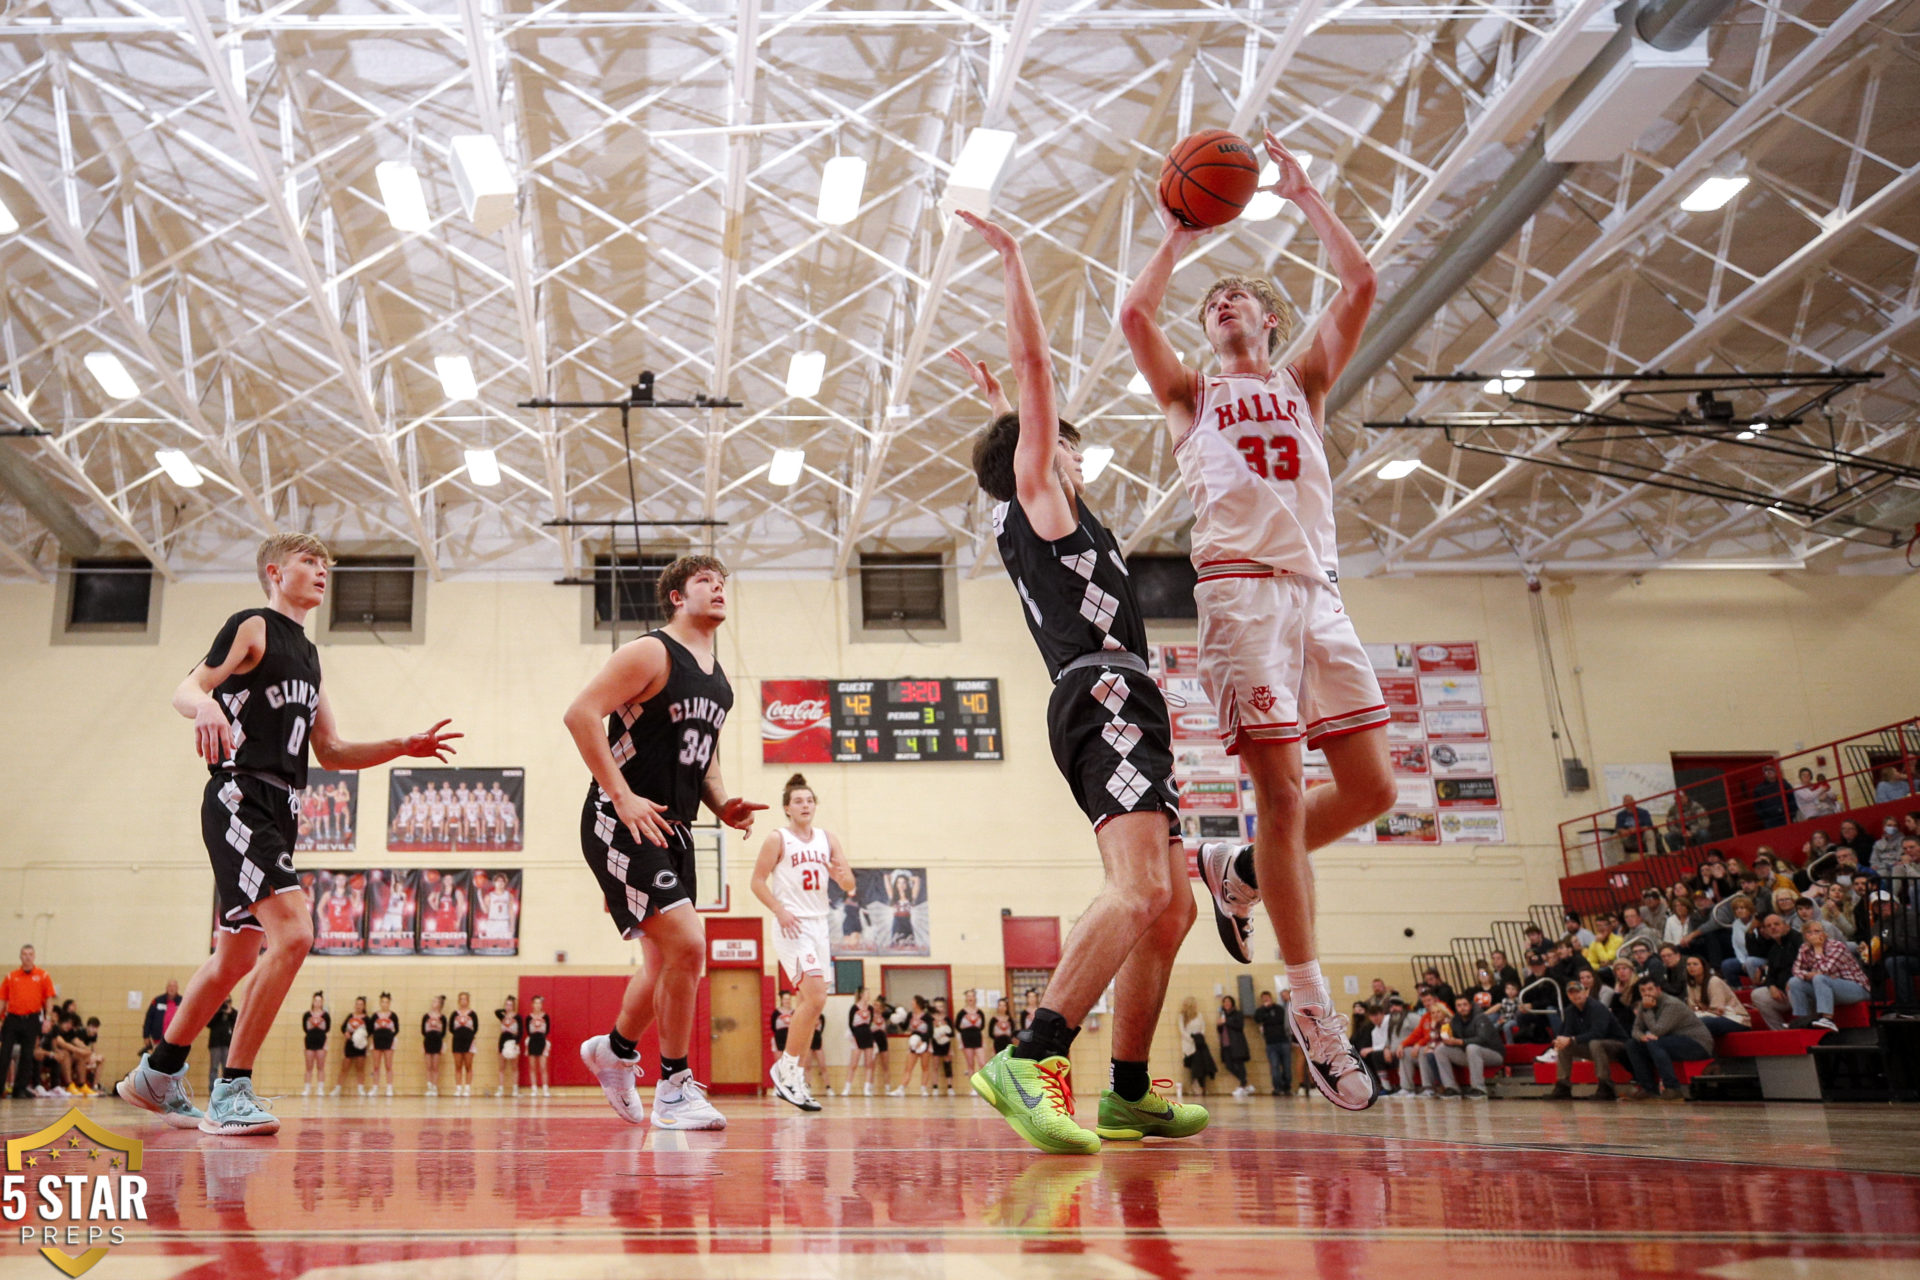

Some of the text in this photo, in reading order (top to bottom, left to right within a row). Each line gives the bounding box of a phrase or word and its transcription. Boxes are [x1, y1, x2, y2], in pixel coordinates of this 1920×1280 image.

[1237, 435, 1301, 481] 33
[837, 682, 874, 692] GUEST
[900, 681, 941, 703] 3:20
[955, 681, 990, 691] HOME
[845, 694, 872, 716] 42
[962, 693, 989, 715] 40
[887, 707, 935, 724] PERIOD 3
[287, 715, 306, 757] 0
[906, 736, 918, 753] 4
[932, 736, 938, 752] 1
[955, 736, 968, 752] 4
[988, 735, 994, 752] 1
[679, 728, 713, 769] 34
[844, 737, 856, 753] 4
[866, 737, 879, 754] 4
[294, 843, 312, 851] ADY
[791, 850, 828, 868] HALLS
[802, 869, 820, 891] 21
